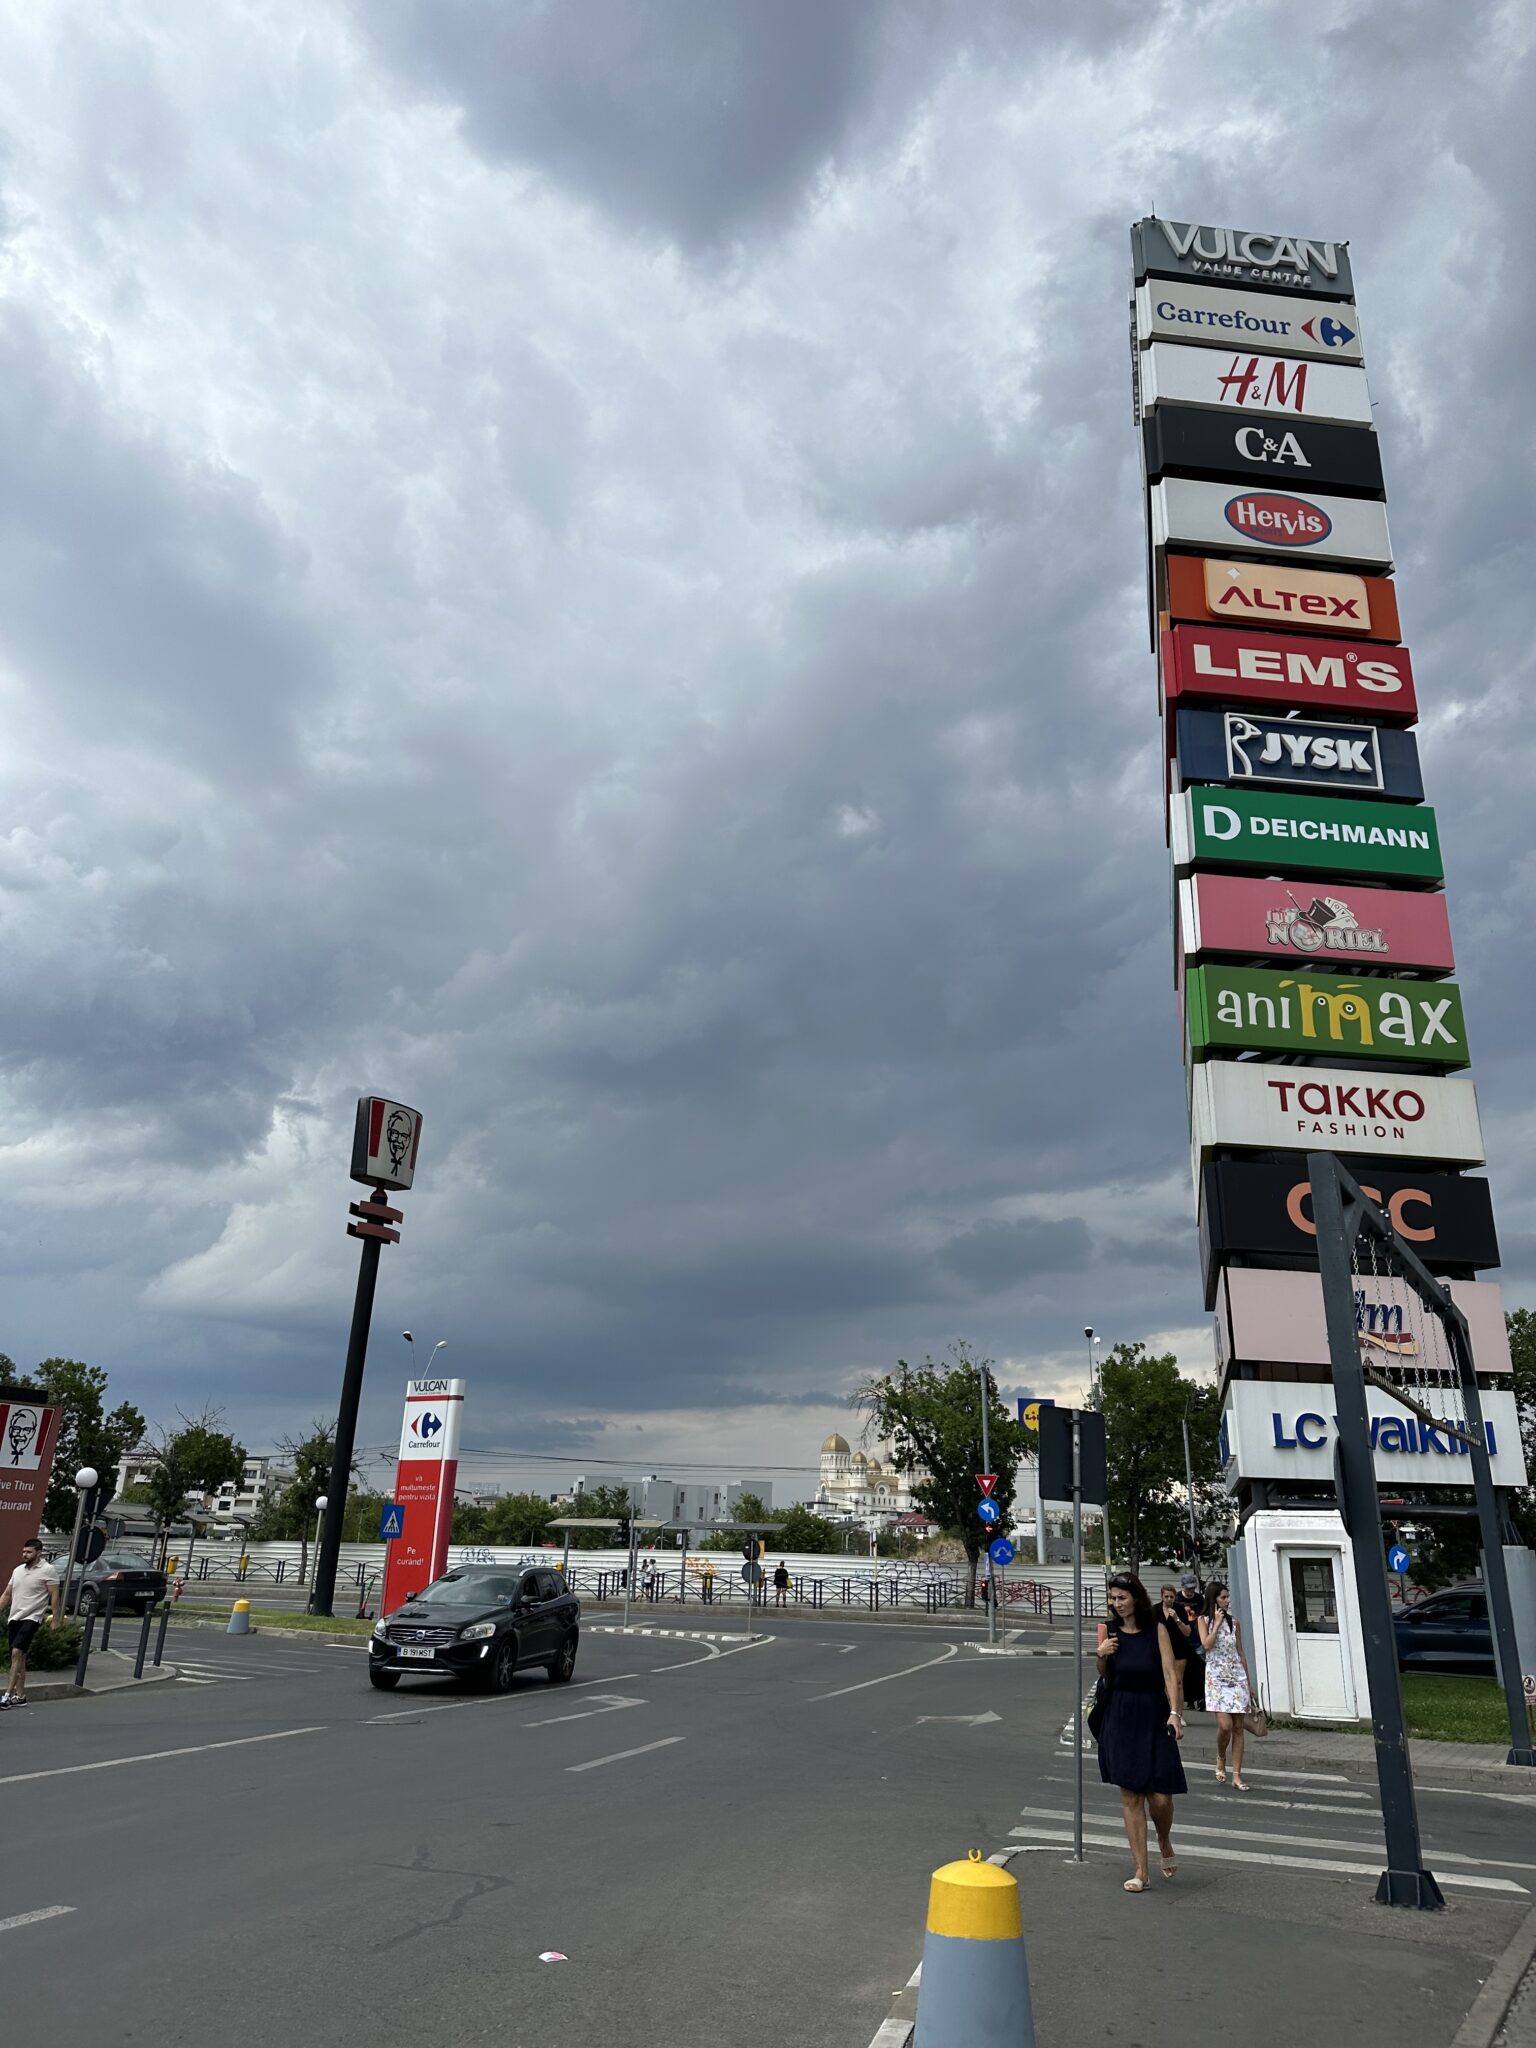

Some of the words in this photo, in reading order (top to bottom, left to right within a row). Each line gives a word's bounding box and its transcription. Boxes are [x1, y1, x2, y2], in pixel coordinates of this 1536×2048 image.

[1160, 221, 1338, 278] VULCAN
[1192, 261, 1242, 276] VALUE
[1251, 270, 1312, 286] CENTRE
[1156, 302, 1290, 336] Carrefour
[1217, 355, 1308, 413] H&M
[1234, 426, 1312, 468] C&A
[1236, 501, 1323, 535] Hervis
[1260, 731, 1374, 774] JYSK
[1250, 816, 1430, 850] DEICHMANN
[1265, 918, 1390, 953] NORIEL
[1216, 979, 1458, 1047] animax
[1297, 1120, 1406, 1140] FASHION
[414, 1380, 448, 1392] VULCAN
[409, 1440, 441, 1449] Carrefour
[14, 1480, 35, 1491] Thru
[398, 1493, 419, 1502] pentru
[407, 1546, 416, 1555] Pe
